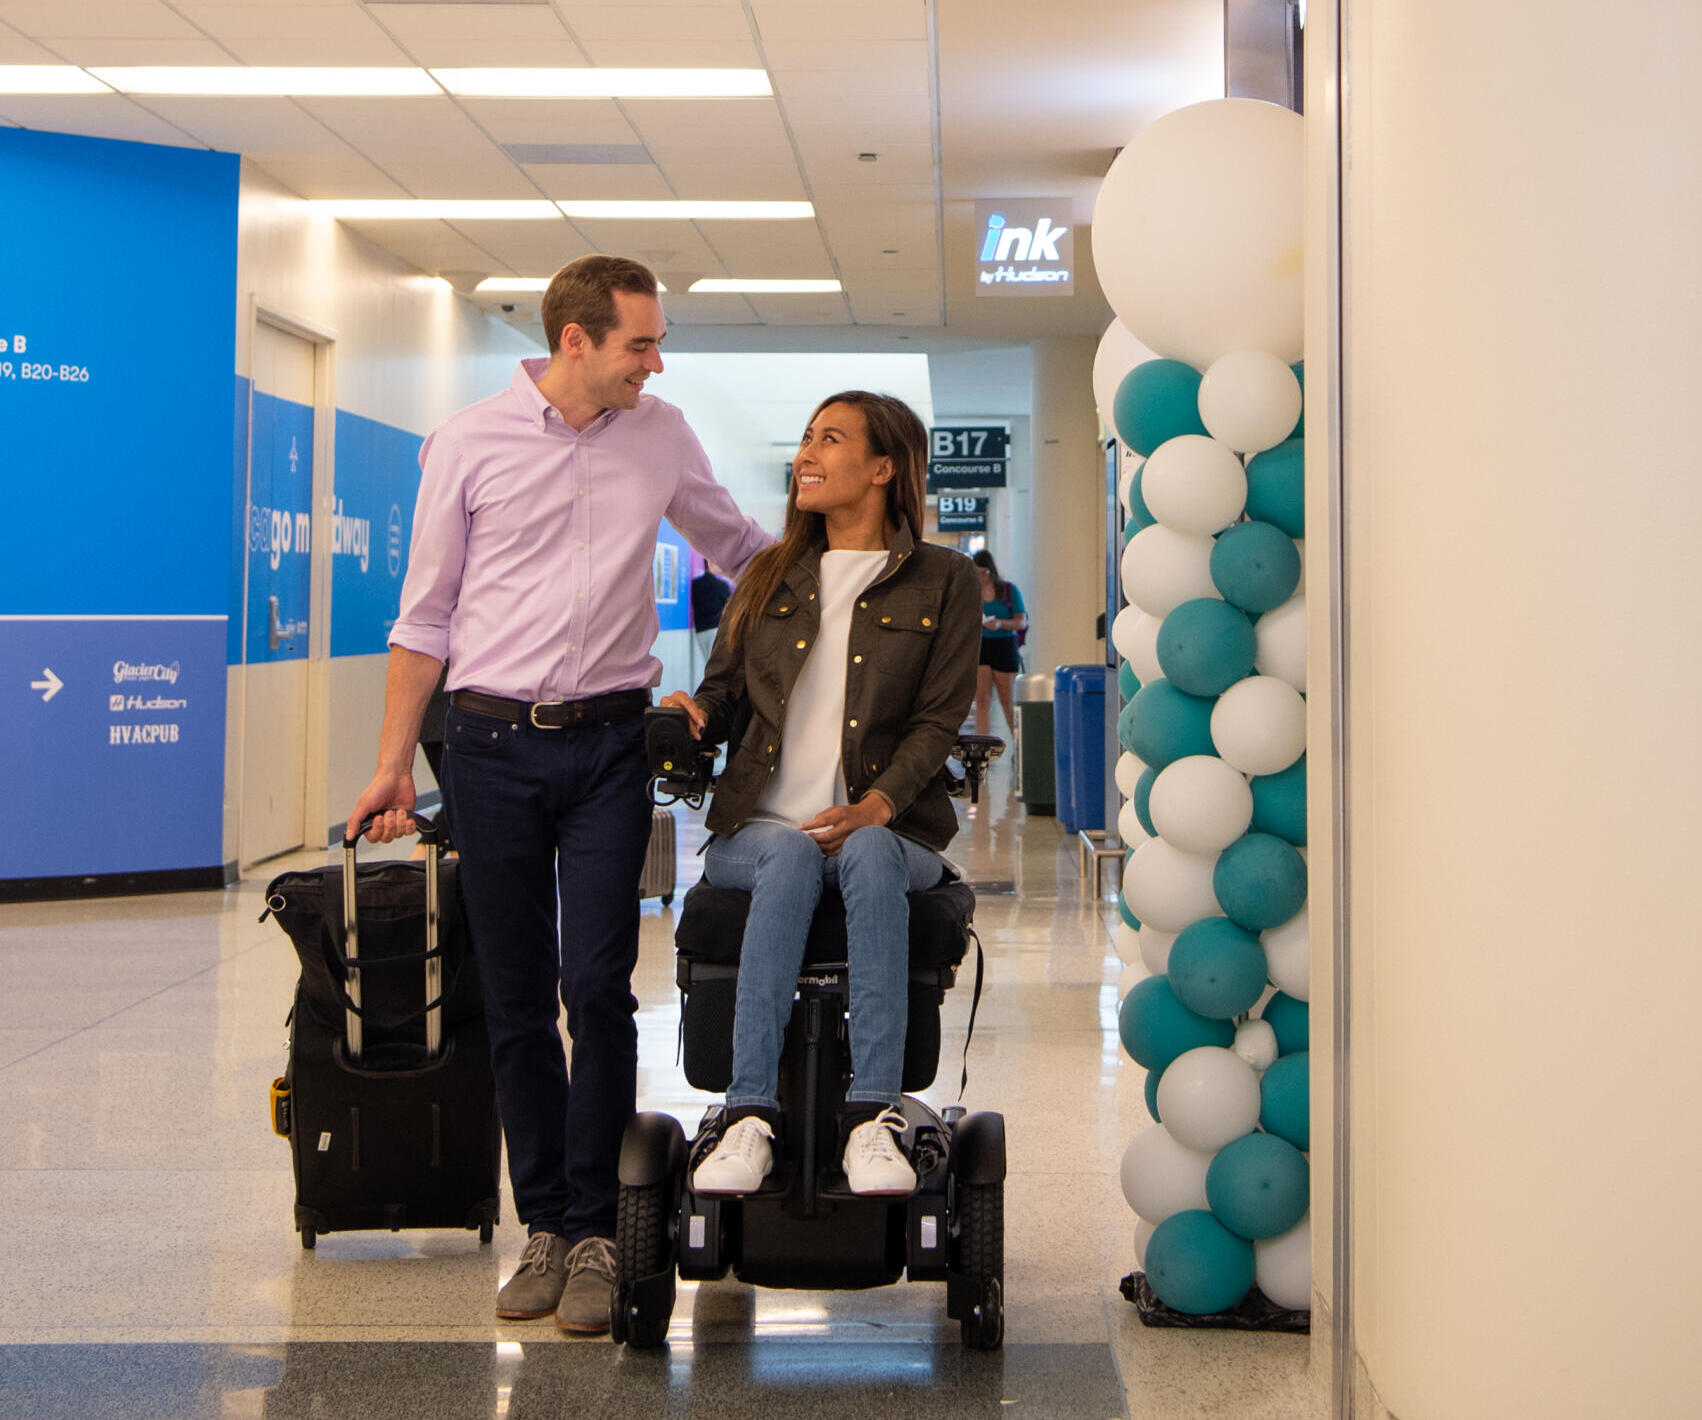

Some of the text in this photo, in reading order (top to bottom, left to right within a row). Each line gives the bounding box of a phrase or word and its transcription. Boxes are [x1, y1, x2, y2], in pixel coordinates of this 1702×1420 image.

[980, 213, 1068, 261] ink
[995, 266, 1069, 282] Hudson
[13, 335, 26, 353] B
[22, 362, 89, 382] B20-B26
[934, 431, 988, 456] B17
[934, 464, 1001, 473] Concourse B
[940, 497, 976, 512] B19
[127, 695, 187, 709] Hudson
